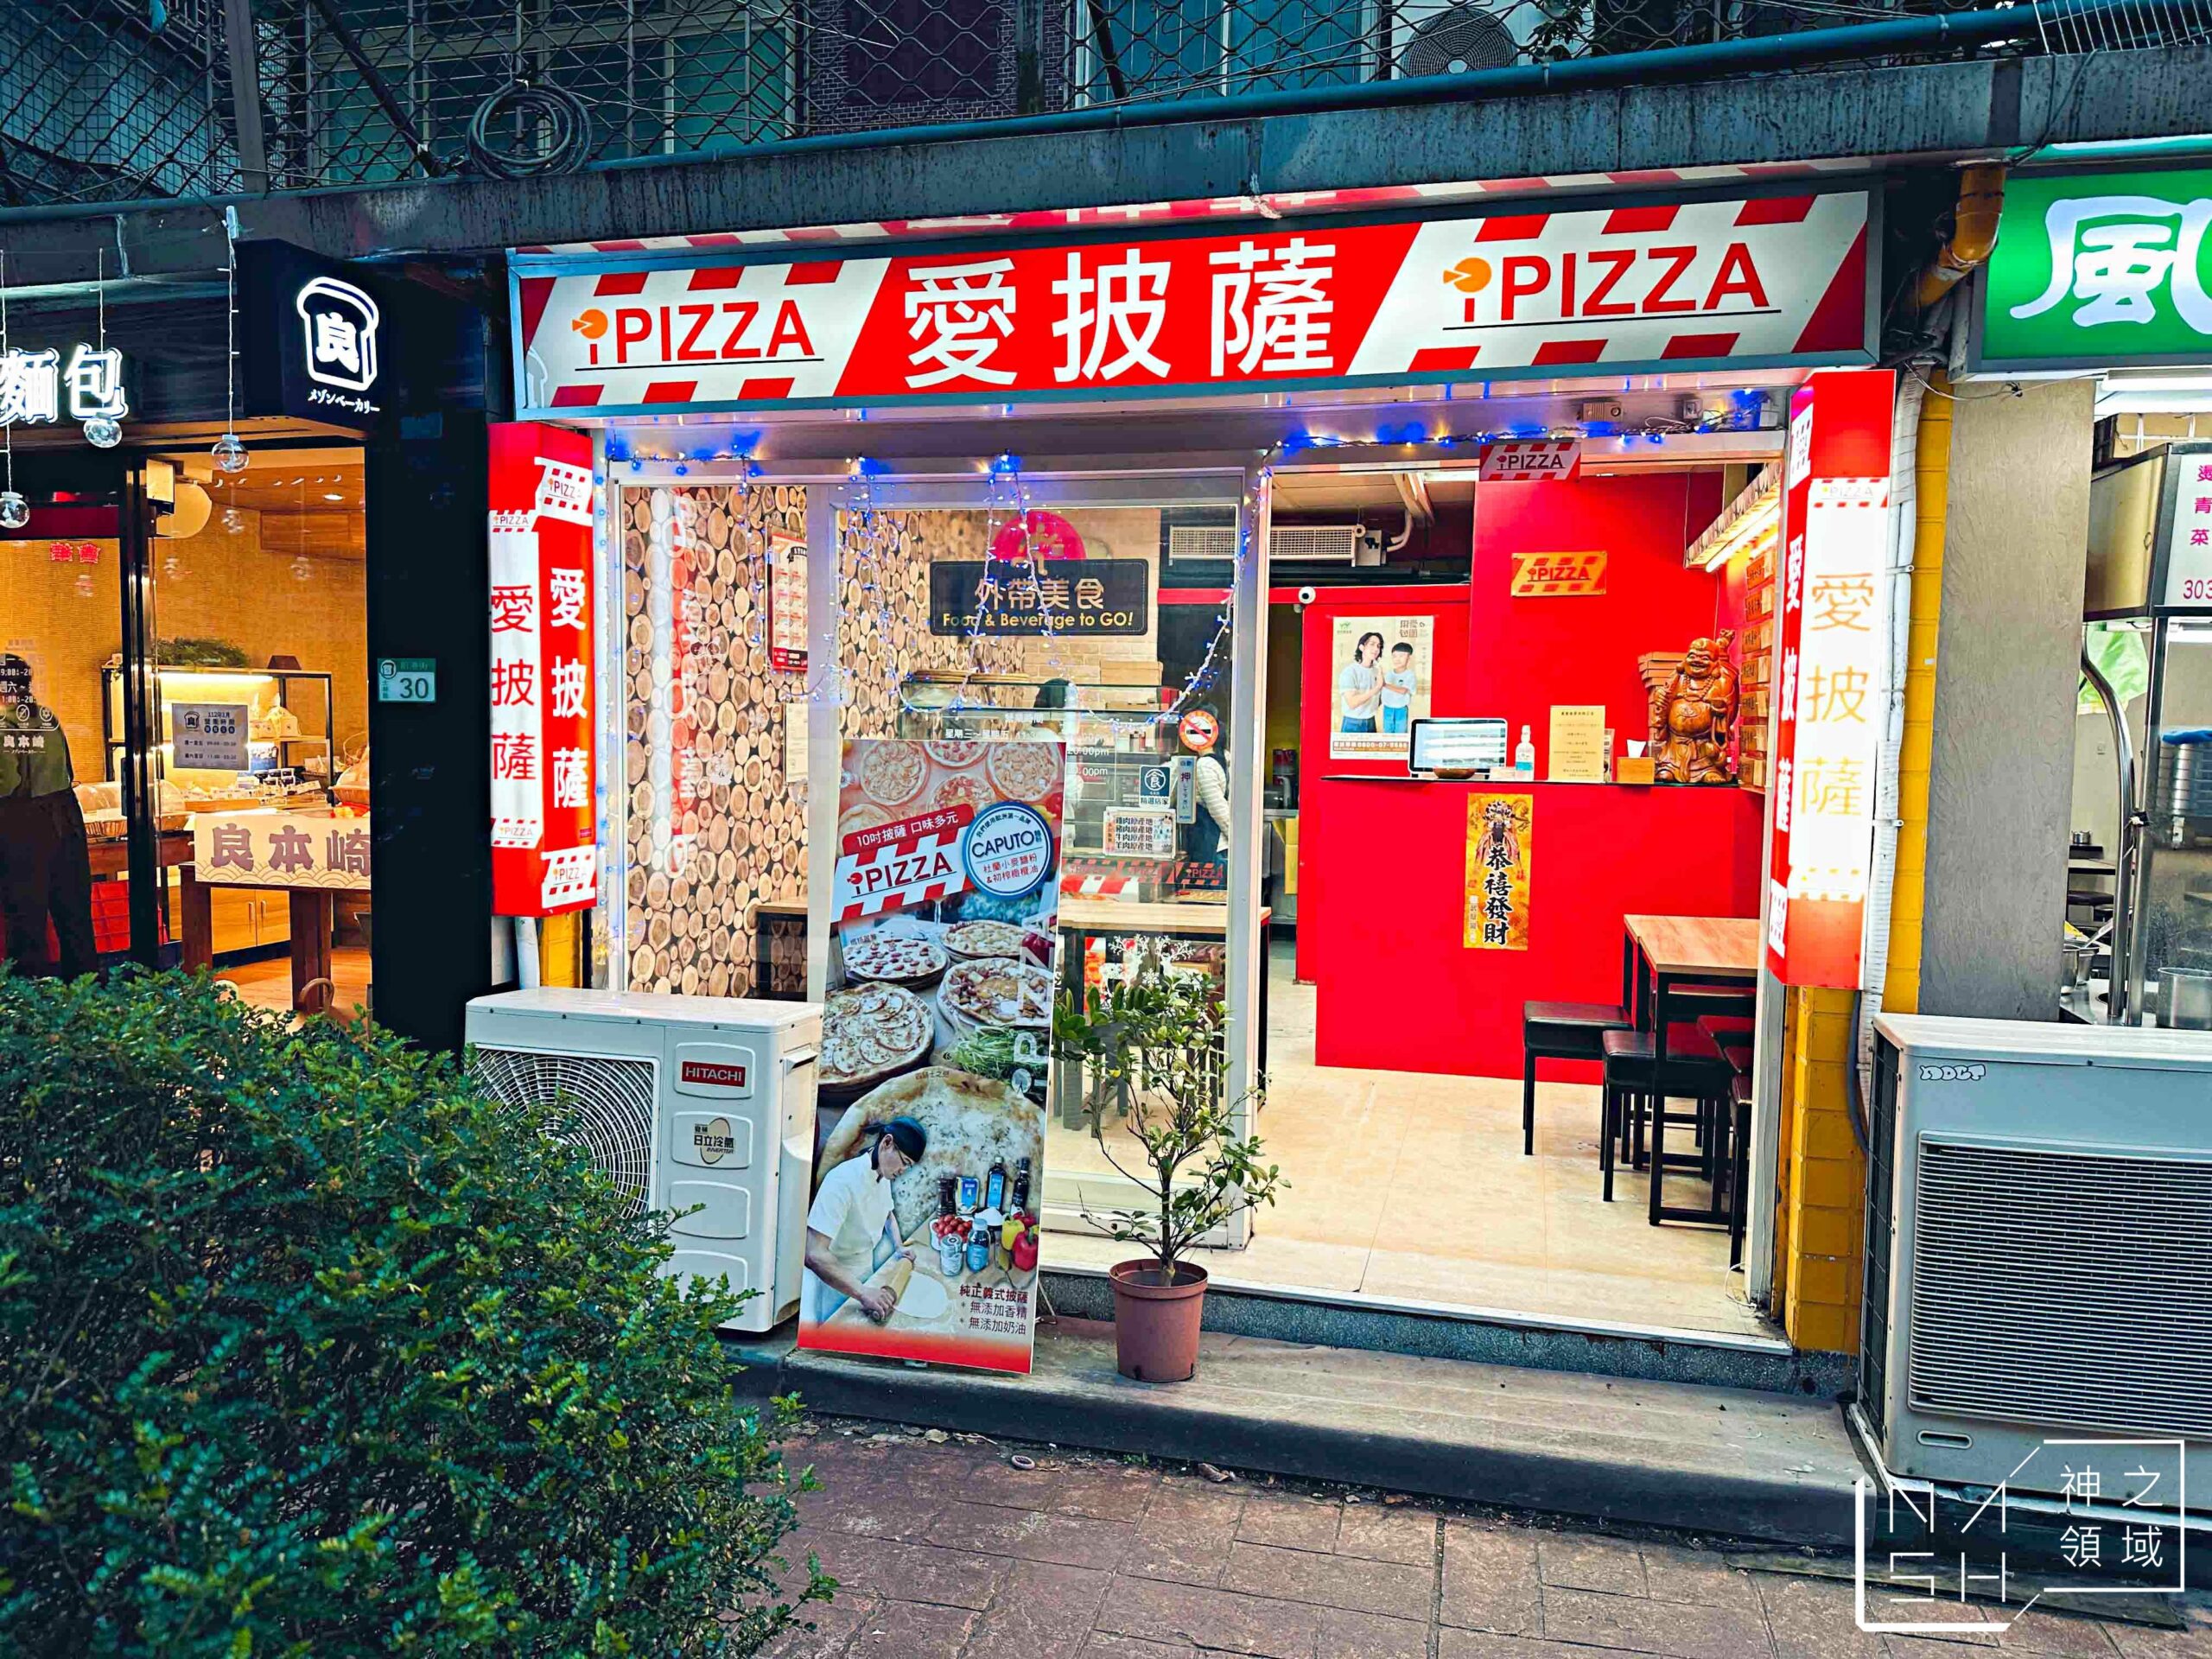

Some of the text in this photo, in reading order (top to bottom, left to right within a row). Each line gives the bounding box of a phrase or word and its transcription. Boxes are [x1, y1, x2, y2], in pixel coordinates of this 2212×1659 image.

[2009, 195, 2212, 335] 風
[903, 237, 1337, 390] 愛披薩
[315, 312, 360, 374] 良
[0, 342, 129, 427] 麵包
[974, 578, 1105, 611] 外帶美食
[984, 613, 995, 627] &
[1000, 613, 1076, 629] Beverage
[1079, 613, 1095, 626] to
[1099, 612, 1134, 627] GO!
[400, 677, 429, 699] 30
[490, 584, 535, 780] 愛披薩
[550, 567, 589, 809] 愛披薩
[1800, 573, 1874, 817] 愛披薩
[856, 811, 959, 848] 10吋披薩 口味多元
[971, 830, 1035, 858] CAPUTO
[211, 823, 370, 876] 良本崎
[1484, 847, 1513, 945] 恭禧發財
[685, 1066, 742, 1082] HITACHI
[694, 1135, 734, 1148] 日立冷氣
[959, 1282, 1028, 1304] 純正義式披薩
[970, 1300, 1028, 1320] 無添加香精
[969, 1317, 1027, 1335] 無添加奶油
